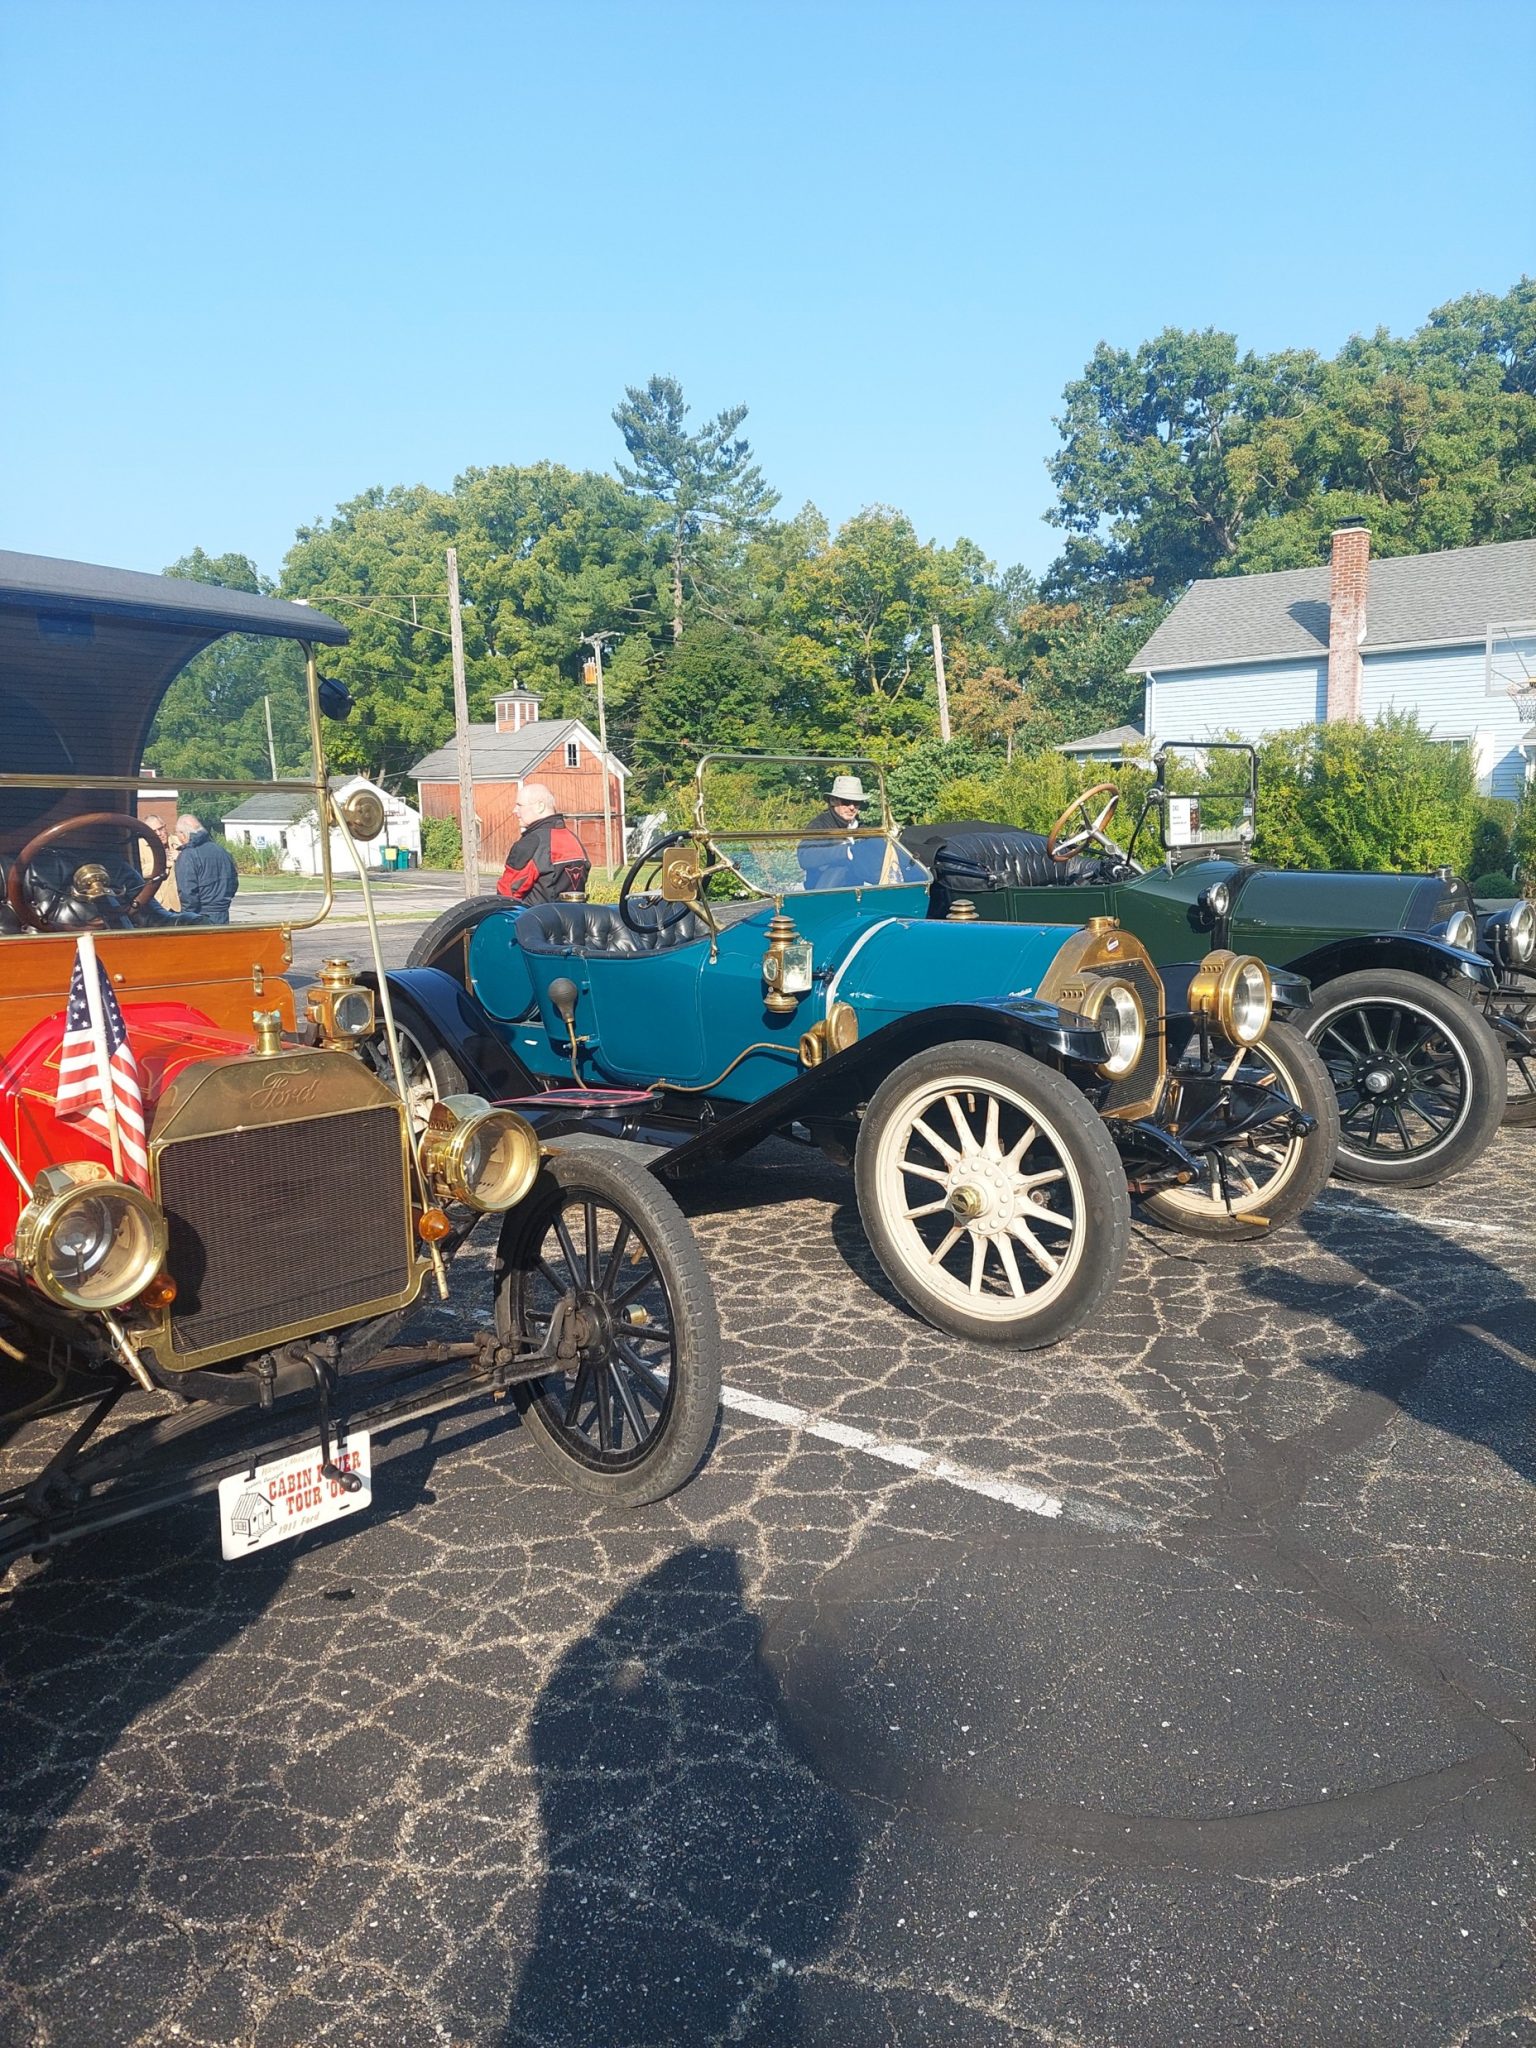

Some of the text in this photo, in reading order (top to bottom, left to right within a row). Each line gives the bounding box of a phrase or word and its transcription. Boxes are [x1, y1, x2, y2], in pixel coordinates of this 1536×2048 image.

[249, 1069, 320, 1110] Ford
[268, 1468, 312, 1500] CABIN
[286, 1487, 322, 1515] TOUR
[279, 1510, 320, 1535] 1911 Ford
